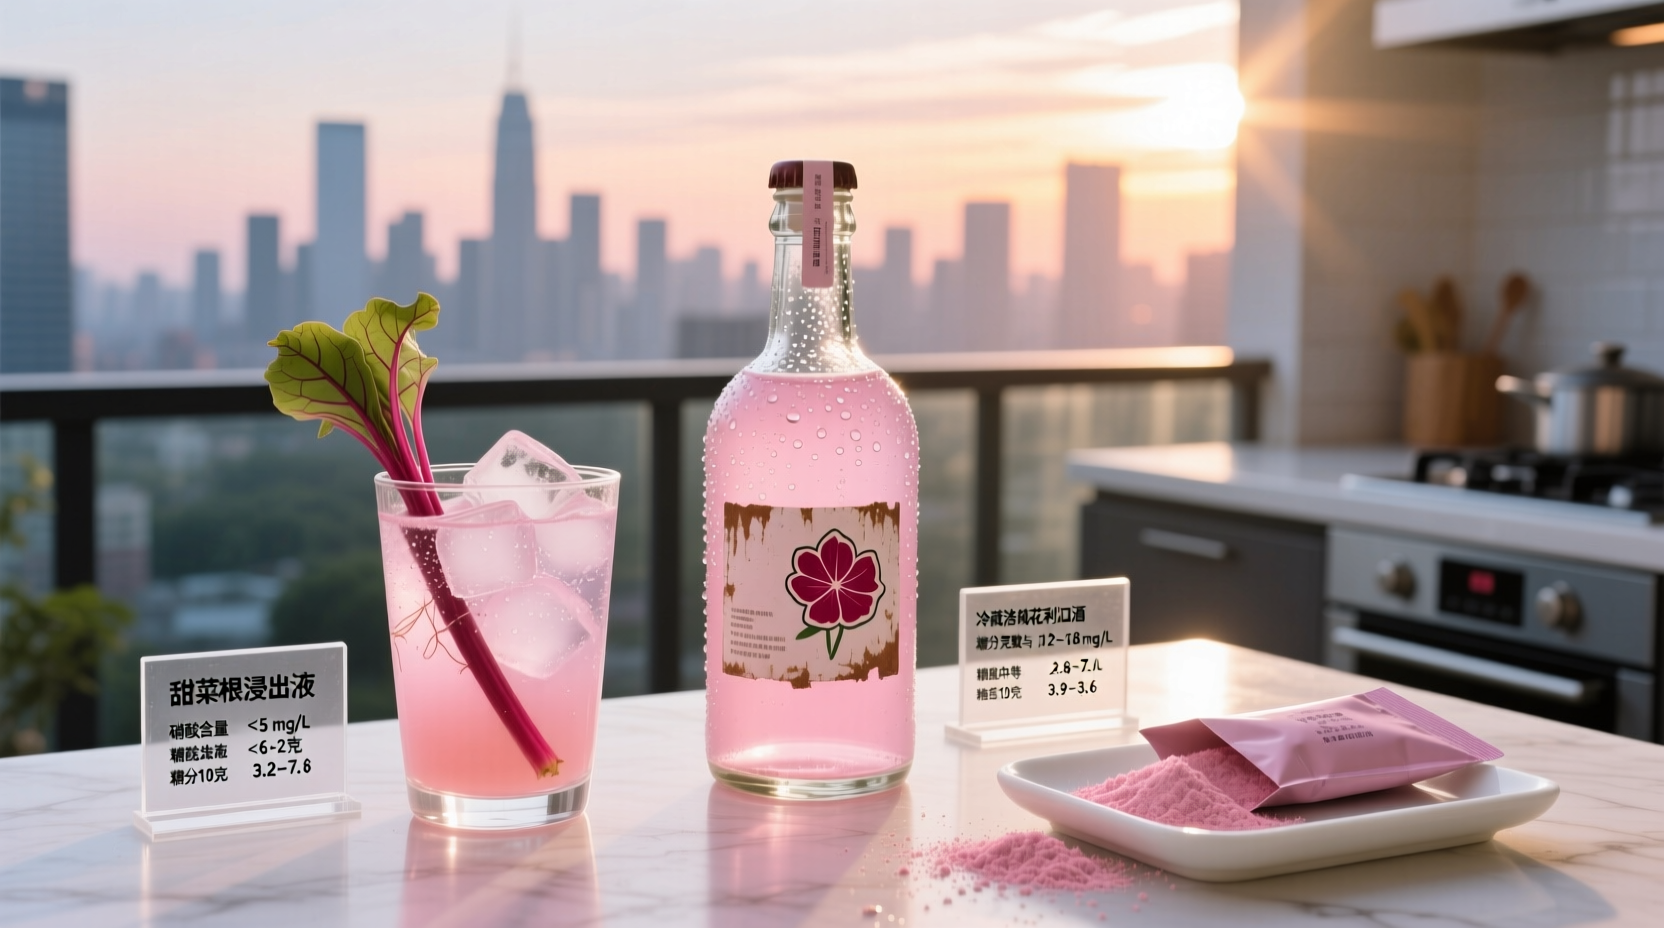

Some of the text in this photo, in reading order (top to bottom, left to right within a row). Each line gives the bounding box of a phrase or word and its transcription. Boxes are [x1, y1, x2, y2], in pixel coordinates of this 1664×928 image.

[169, 672, 316, 707] 甜菜根浸出液
[272, 714, 311, 735] mg/L
